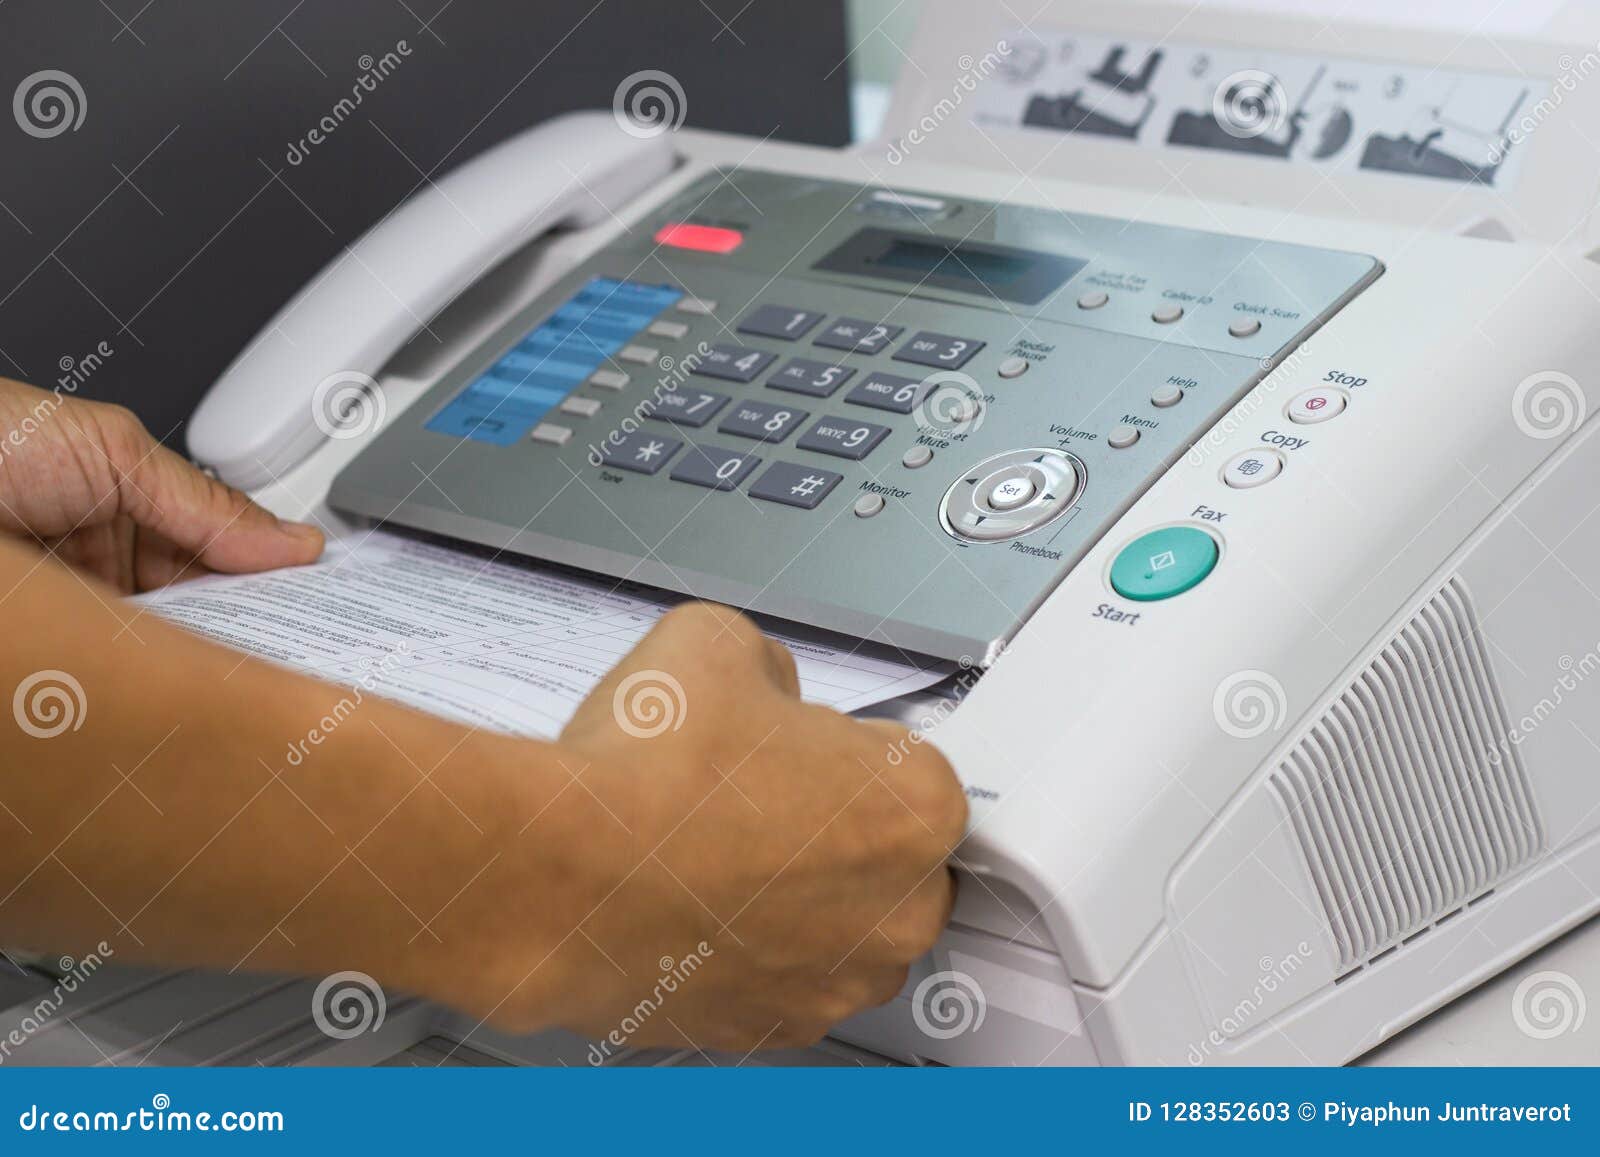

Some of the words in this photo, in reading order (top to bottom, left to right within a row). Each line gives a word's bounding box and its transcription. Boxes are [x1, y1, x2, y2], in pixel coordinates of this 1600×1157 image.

[1161, 288, 1194, 302] Caller
[1233, 301, 1268, 316] Quick
[1269, 307, 1301, 320] Scan
[784, 313, 805, 331] 1
[859, 327, 887, 346] 2
[911, 340, 937, 353] DEF
[939, 341, 967, 360] 3
[734, 353, 760, 371] 4
[812, 367, 842, 387] 5
[1166, 375, 1198, 389] Help
[1322, 370, 1368, 390] Stop
[866, 382, 893, 395] MNO
[894, 383, 920, 402] 6
[686, 395, 714, 414] 7
[738, 409, 763, 421] TUV
[764, 411, 791, 431] 8
[1120, 414, 1160, 430] Menu
[816, 425, 847, 438] WXYZ
[842, 427, 871, 447] 9
[1049, 423, 1098, 441] Volume
[1260, 430, 1310, 451] Copy
[916, 435, 950, 449] Mute
[716, 458, 742, 478] 0
[791, 474, 824, 496] #
[859, 480, 911, 499] Monitor
[999, 483, 1020, 496] Set
[1191, 505, 1227, 523] Fax
[1009, 541, 1063, 561] Phonebook
[1092, 603, 1141, 626] Start
